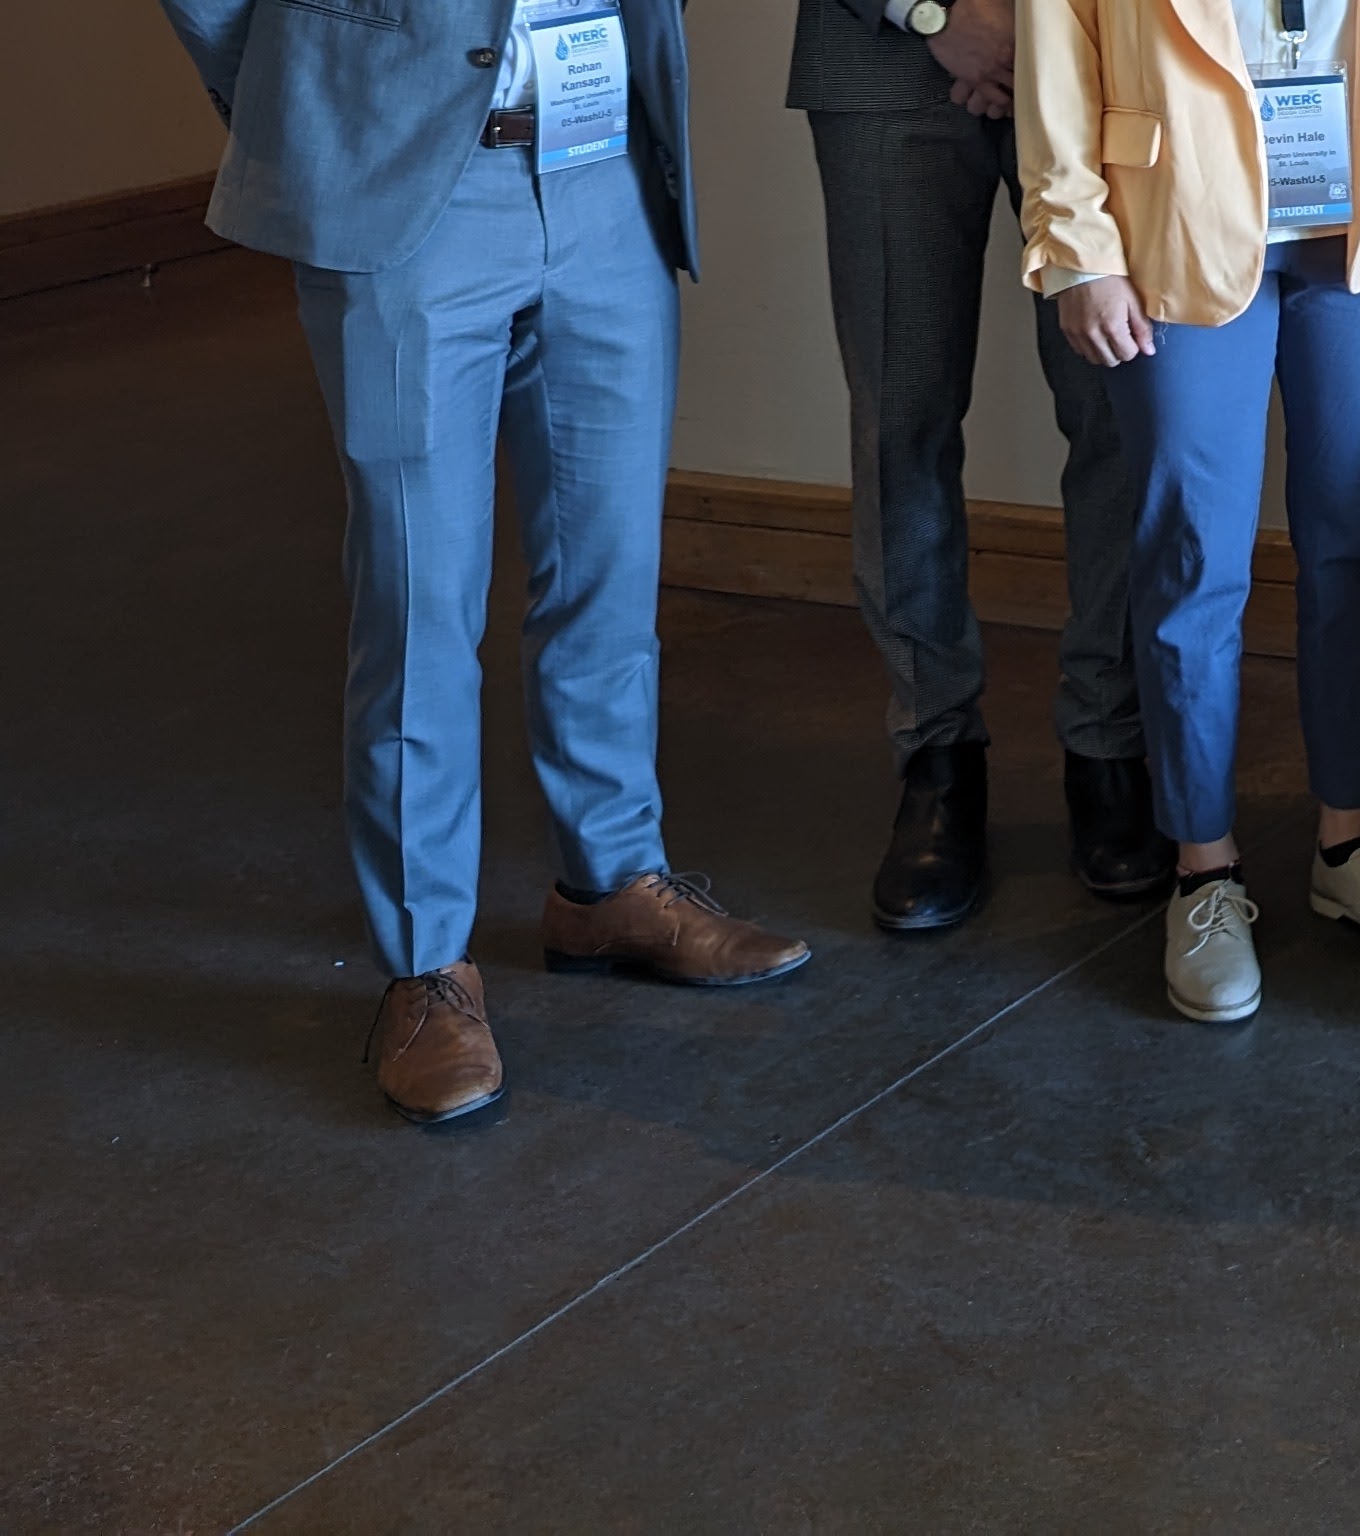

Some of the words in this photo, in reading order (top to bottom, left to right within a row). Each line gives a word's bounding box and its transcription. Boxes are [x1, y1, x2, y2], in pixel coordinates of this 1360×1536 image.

[568, 27, 608, 44] WERC
[567, 61, 603, 76] Rohan
[561, 75, 611, 93] Kansagra
[1275, 93, 1322, 106] WERC
[561, 108, 613, 128] 05-WashU-5
[1297, 131, 1325, 143] Hale
[567, 138, 611, 157] STUDENT
[1268, 174, 1326, 187] 5-WashU-5
[1273, 204, 1326, 218] STUDENT
